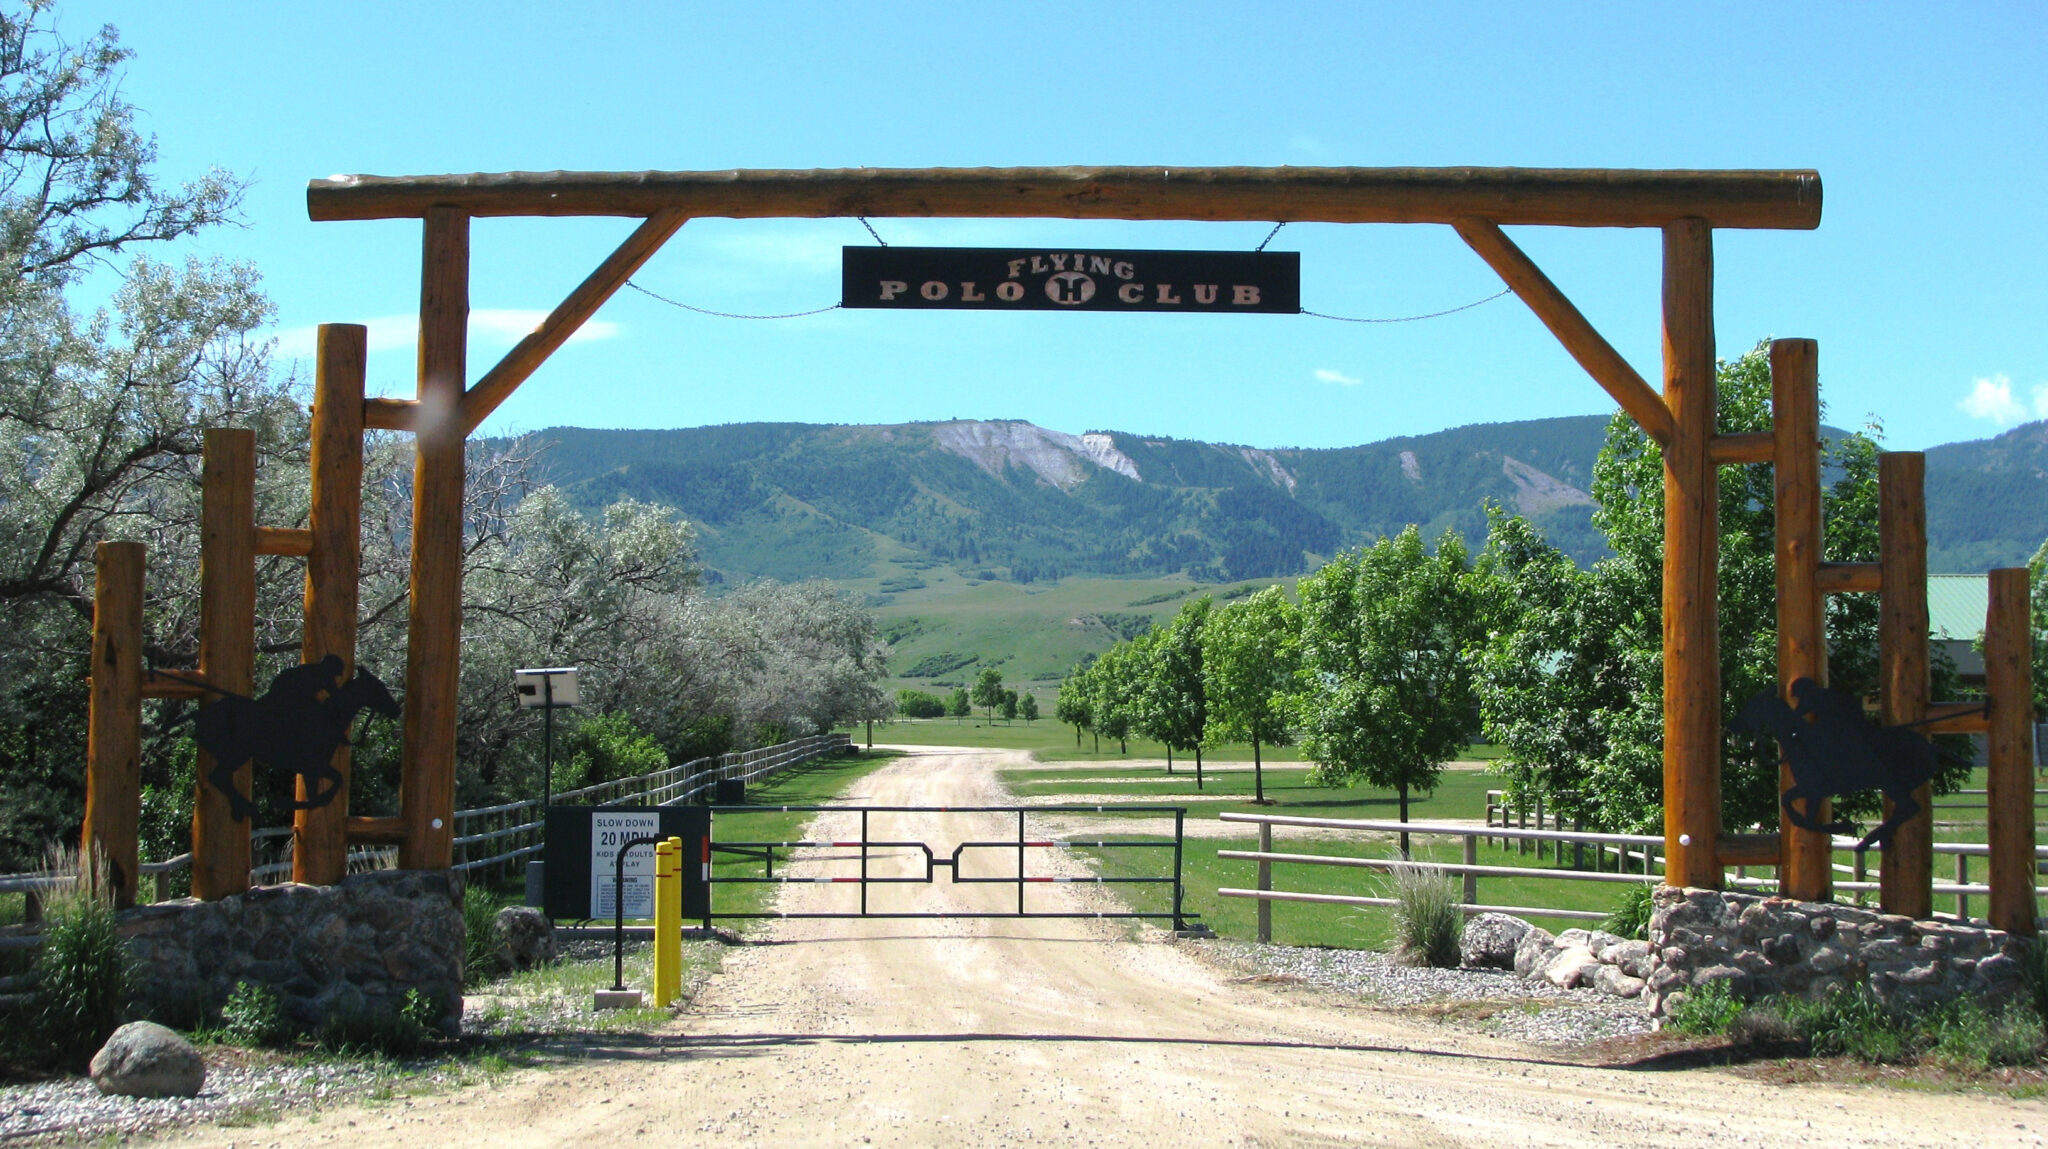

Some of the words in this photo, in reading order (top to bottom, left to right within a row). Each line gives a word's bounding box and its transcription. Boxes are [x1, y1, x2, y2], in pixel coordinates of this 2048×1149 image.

[1007, 253, 1134, 280] FLYING
[879, 280, 1025, 302] POLO
[1052, 276, 1090, 305] H
[1118, 282, 1262, 305] CLUB
[597, 819, 623, 827] SLOW
[625, 819, 654, 827] DOWN
[601, 831, 616, 846] 20
